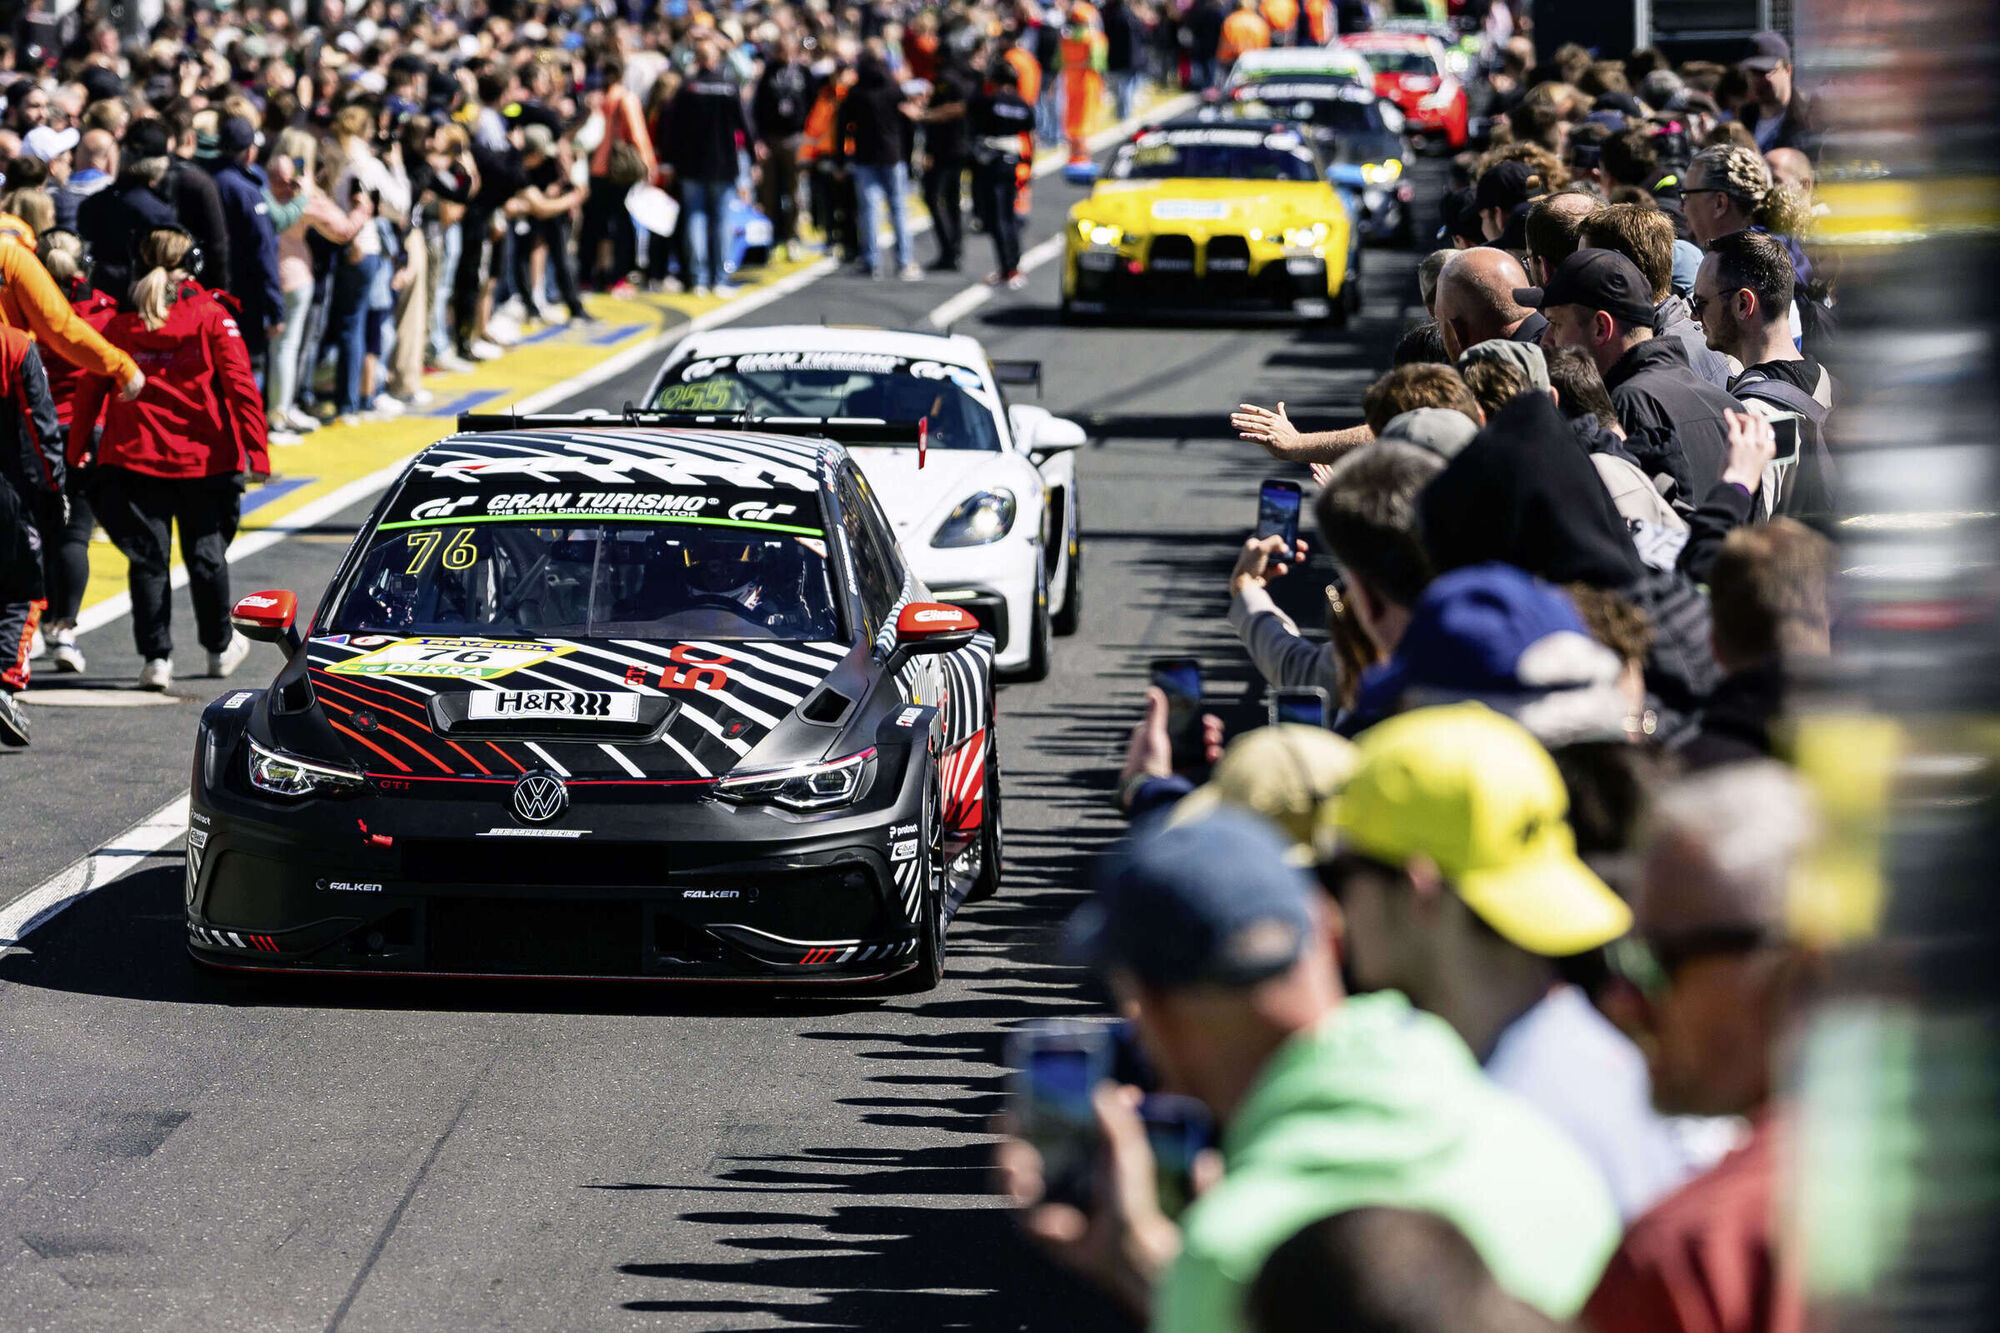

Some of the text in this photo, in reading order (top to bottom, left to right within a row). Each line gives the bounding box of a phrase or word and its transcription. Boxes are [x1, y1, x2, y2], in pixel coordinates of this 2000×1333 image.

[487, 492, 573, 510] GRAN
[517, 507, 553, 515] REAL
[556, 507, 615, 515] DRIVING
[617, 508, 699, 518] SIMULATOR
[405, 528, 478, 575] 76
[418, 647, 493, 663] 76
[385, 662, 483, 678] DEKRA
[496, 691, 574, 713] H&R
[380, 780, 411, 790] GTI
[329, 882, 383, 892] FALKEN
[682, 890, 740, 899] FALKEN
